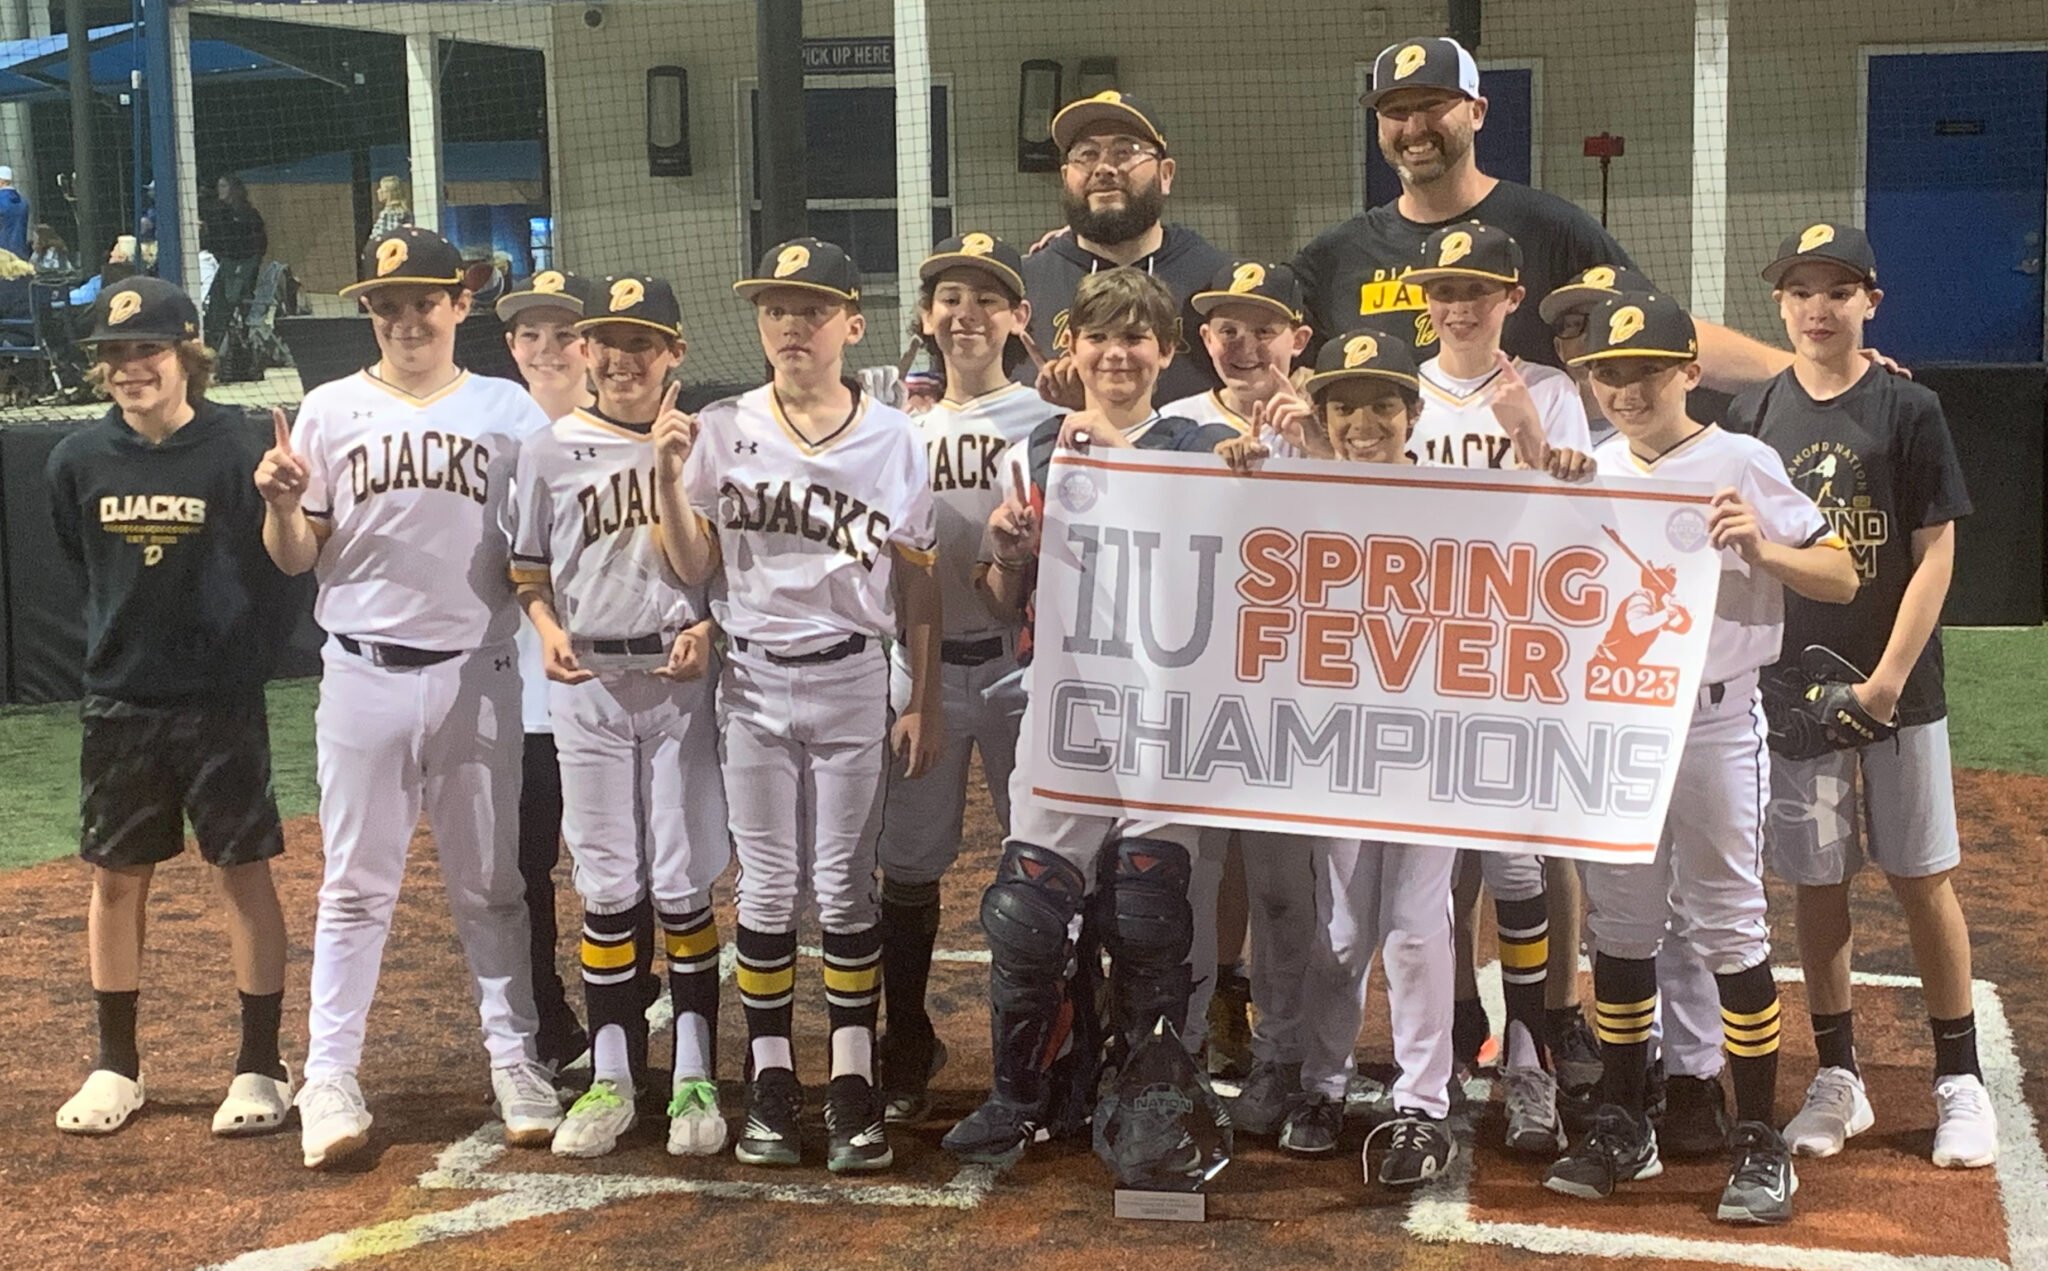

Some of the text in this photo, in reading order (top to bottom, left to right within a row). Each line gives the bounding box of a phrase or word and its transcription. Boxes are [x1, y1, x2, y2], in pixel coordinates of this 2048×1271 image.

[832, 46, 851, 65] UP
[854, 45, 891, 64] HERE
[348, 431, 490, 505] DJACKS
[927, 433, 1015, 492] ACK
[100, 495, 206, 523] DJACKS
[720, 481, 891, 573] DJACKS
[1235, 526, 1608, 627] SPRING
[1235, 604, 1569, 705] FEVER
[1589, 664, 1676, 700] 2023
[1048, 679, 1674, 818] CHAMPIONS
[1135, 1098, 1192, 1112] NATION
